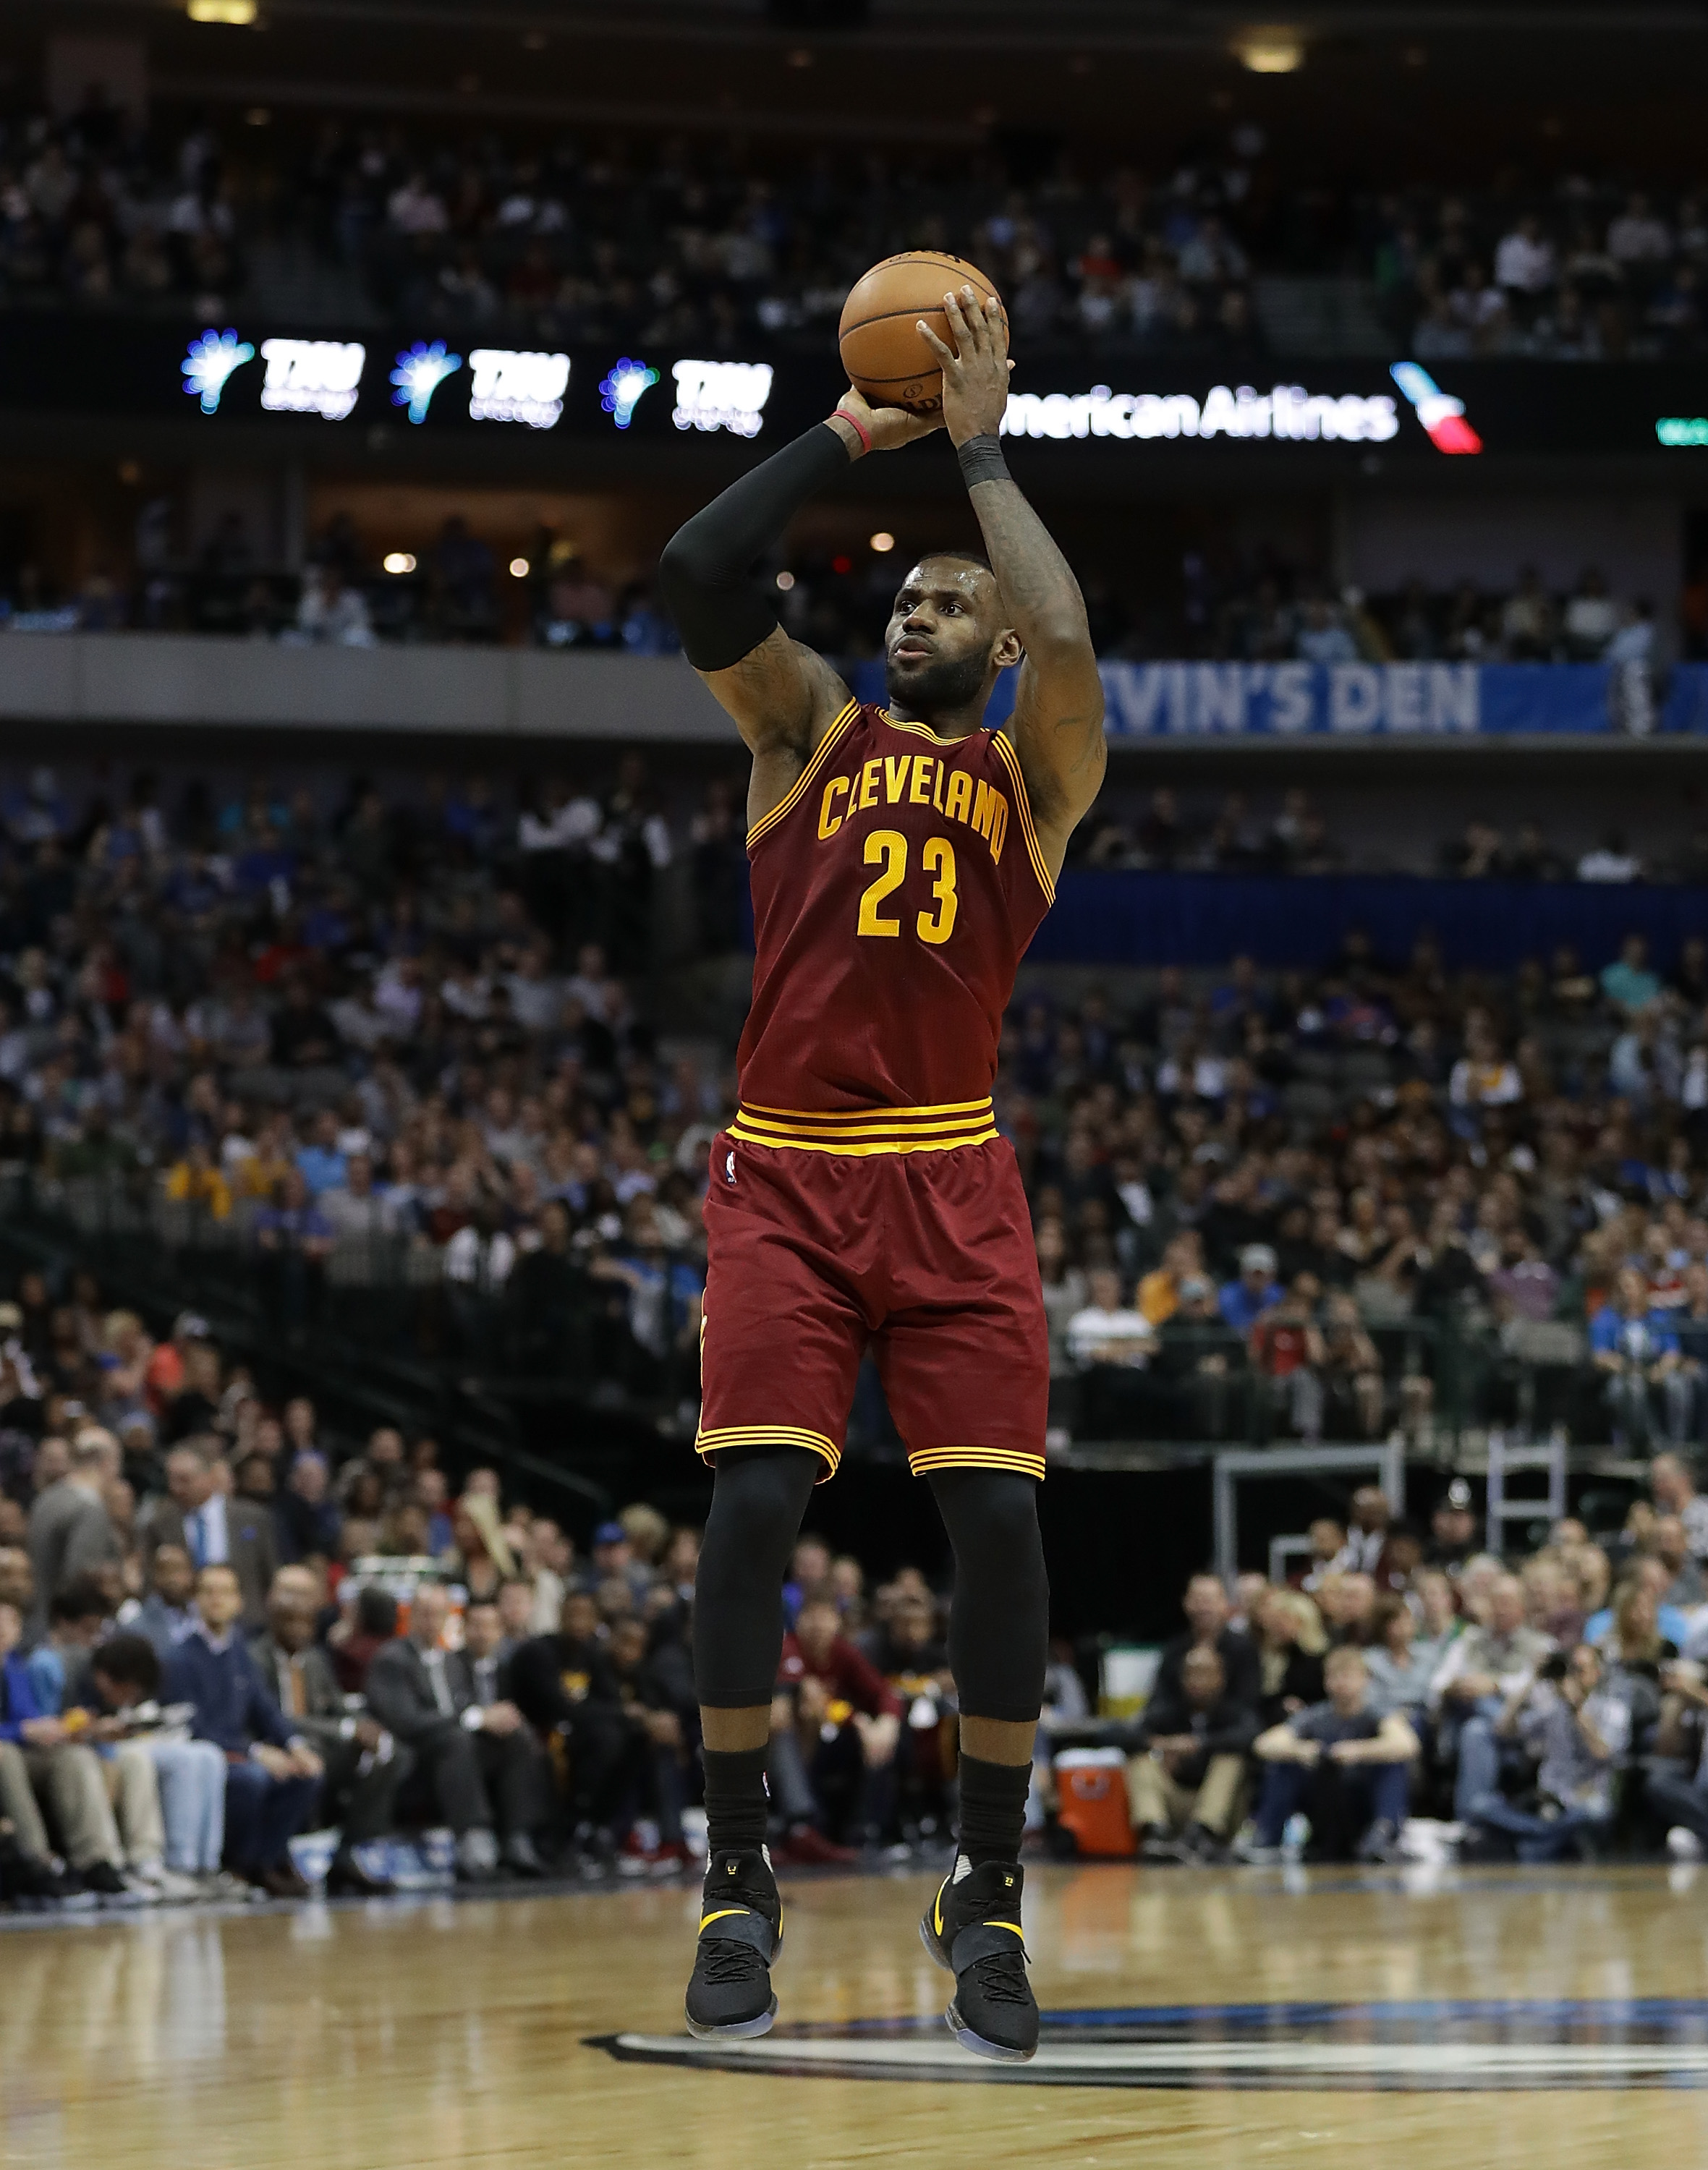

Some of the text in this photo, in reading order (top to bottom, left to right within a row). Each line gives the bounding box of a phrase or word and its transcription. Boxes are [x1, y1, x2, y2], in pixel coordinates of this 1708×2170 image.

[999, 385, 1399, 441] merican Airlines
[1331, 659, 1479, 731] DEN
[817, 755, 1009, 866] CLEVELAND
[857, 830, 959, 944] 23
